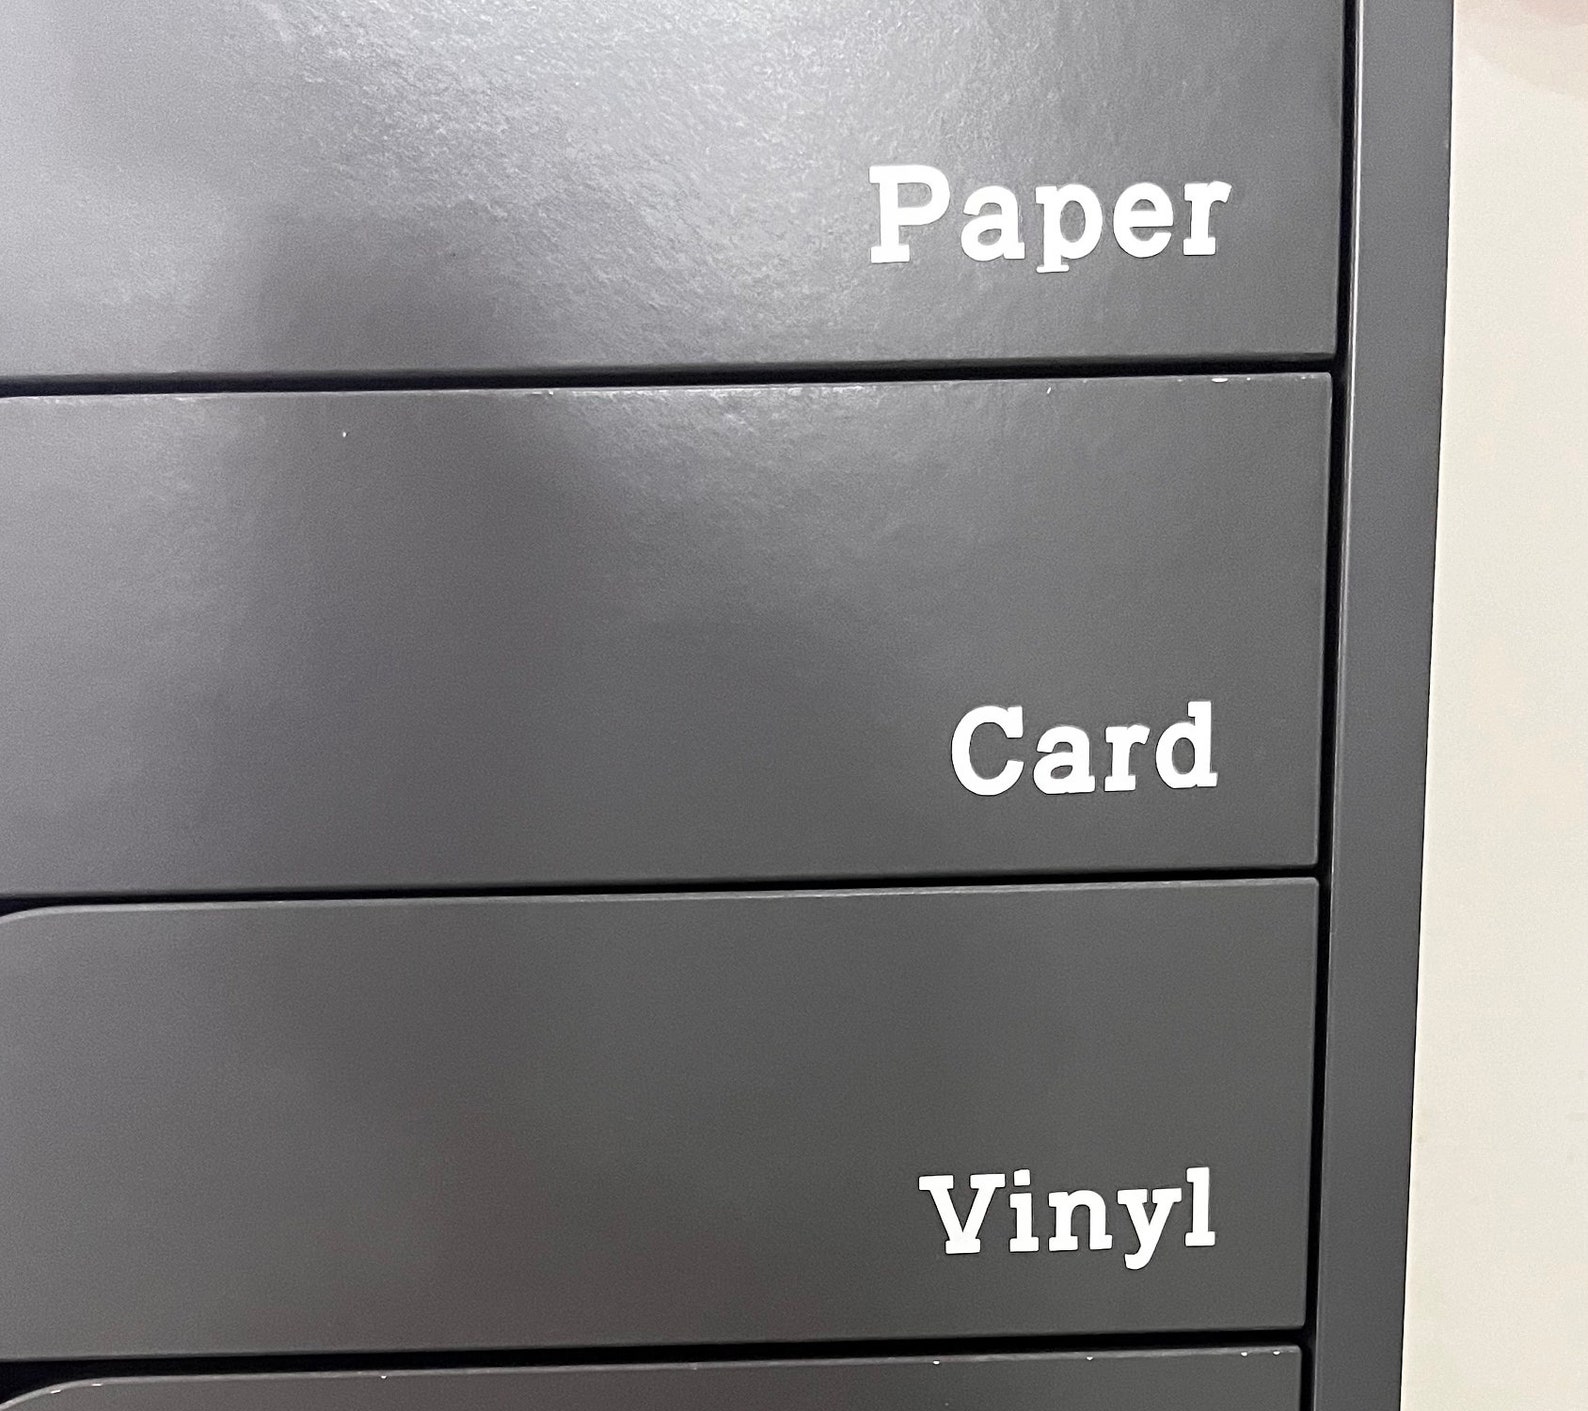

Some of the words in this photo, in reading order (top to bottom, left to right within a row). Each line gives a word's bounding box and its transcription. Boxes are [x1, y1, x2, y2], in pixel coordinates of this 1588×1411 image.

[869, 163, 1232, 273] Paper
[951, 701, 1218, 796] Card
[919, 1167, 1216, 1270] Vinyl
